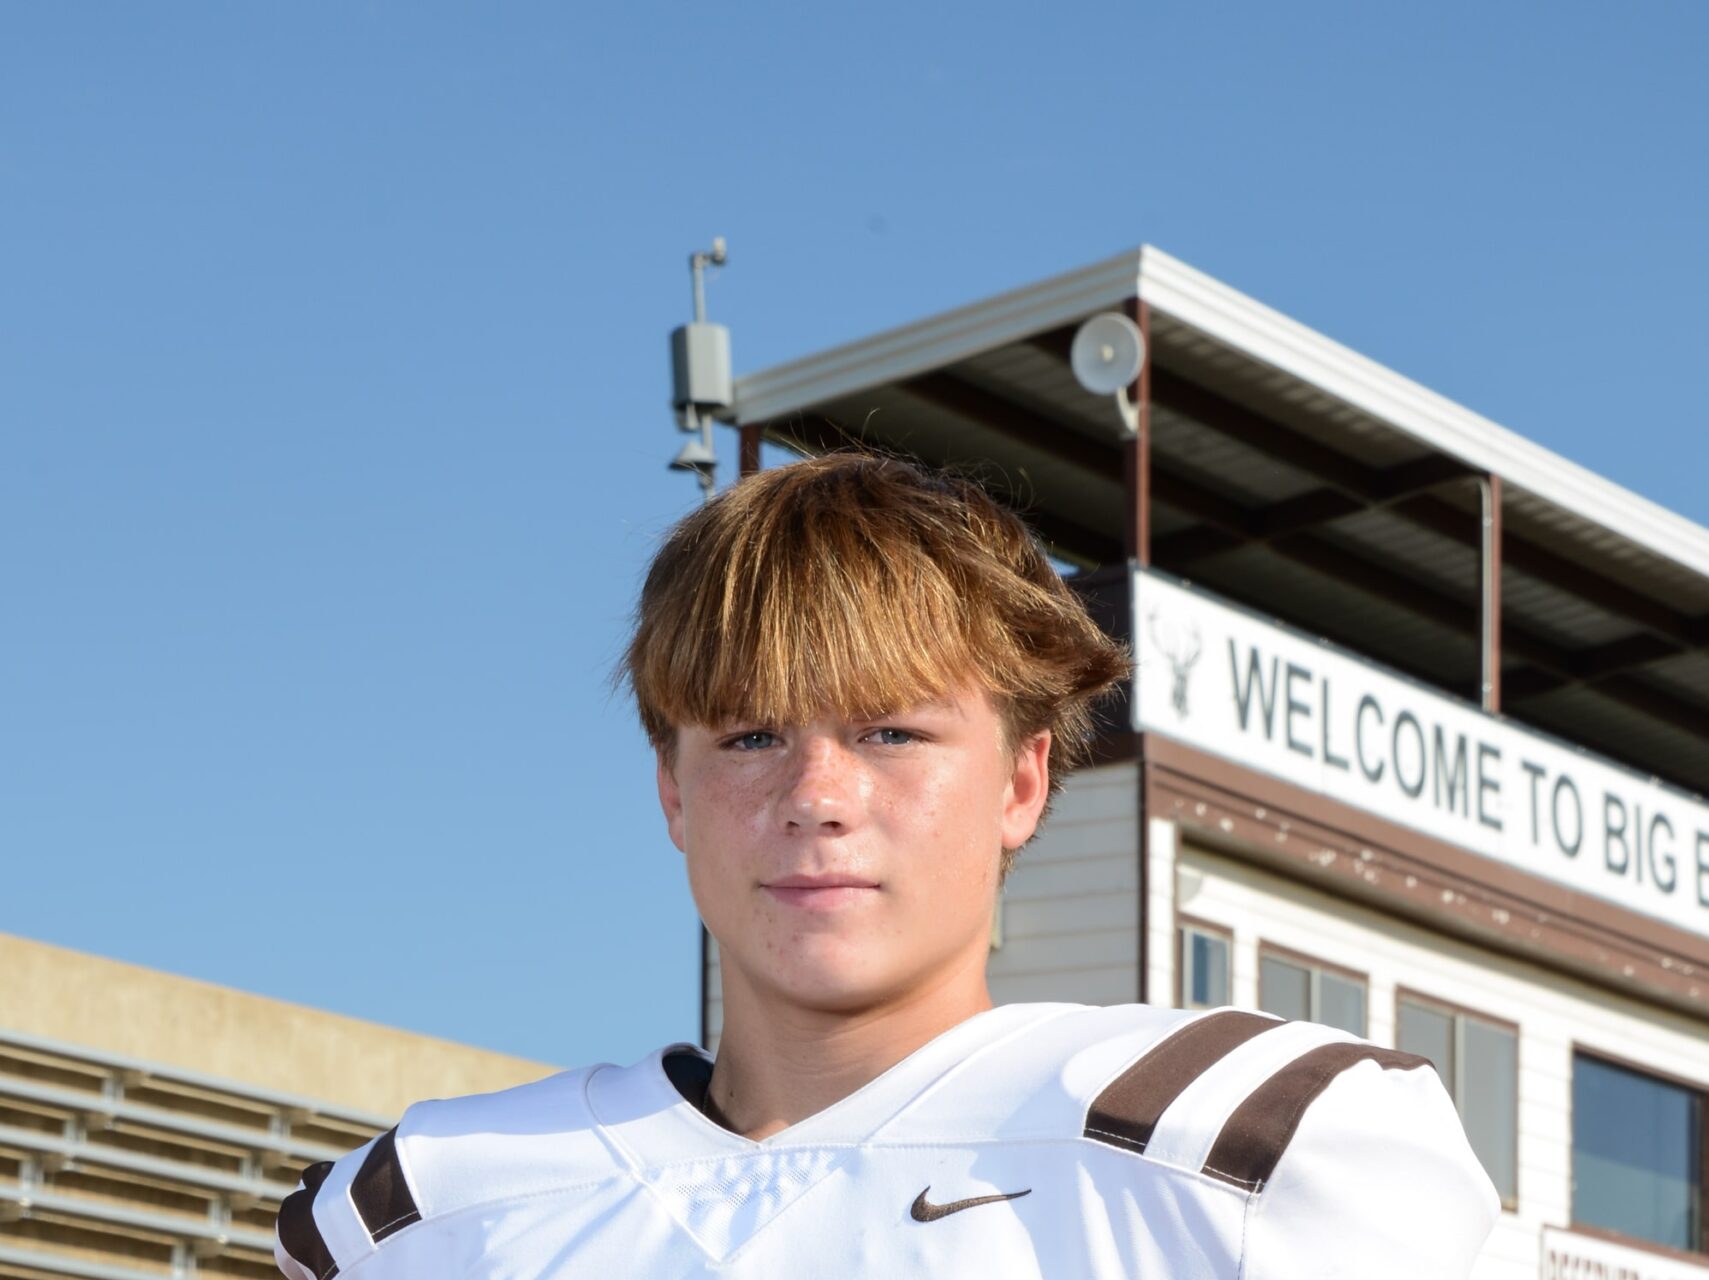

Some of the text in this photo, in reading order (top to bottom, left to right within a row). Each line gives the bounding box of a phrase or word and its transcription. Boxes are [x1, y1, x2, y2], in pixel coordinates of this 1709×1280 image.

[1228, 637, 1503, 831] WELCOME
[1521, 760, 1584, 858] TO
[1603, 791, 1677, 894] BIG
